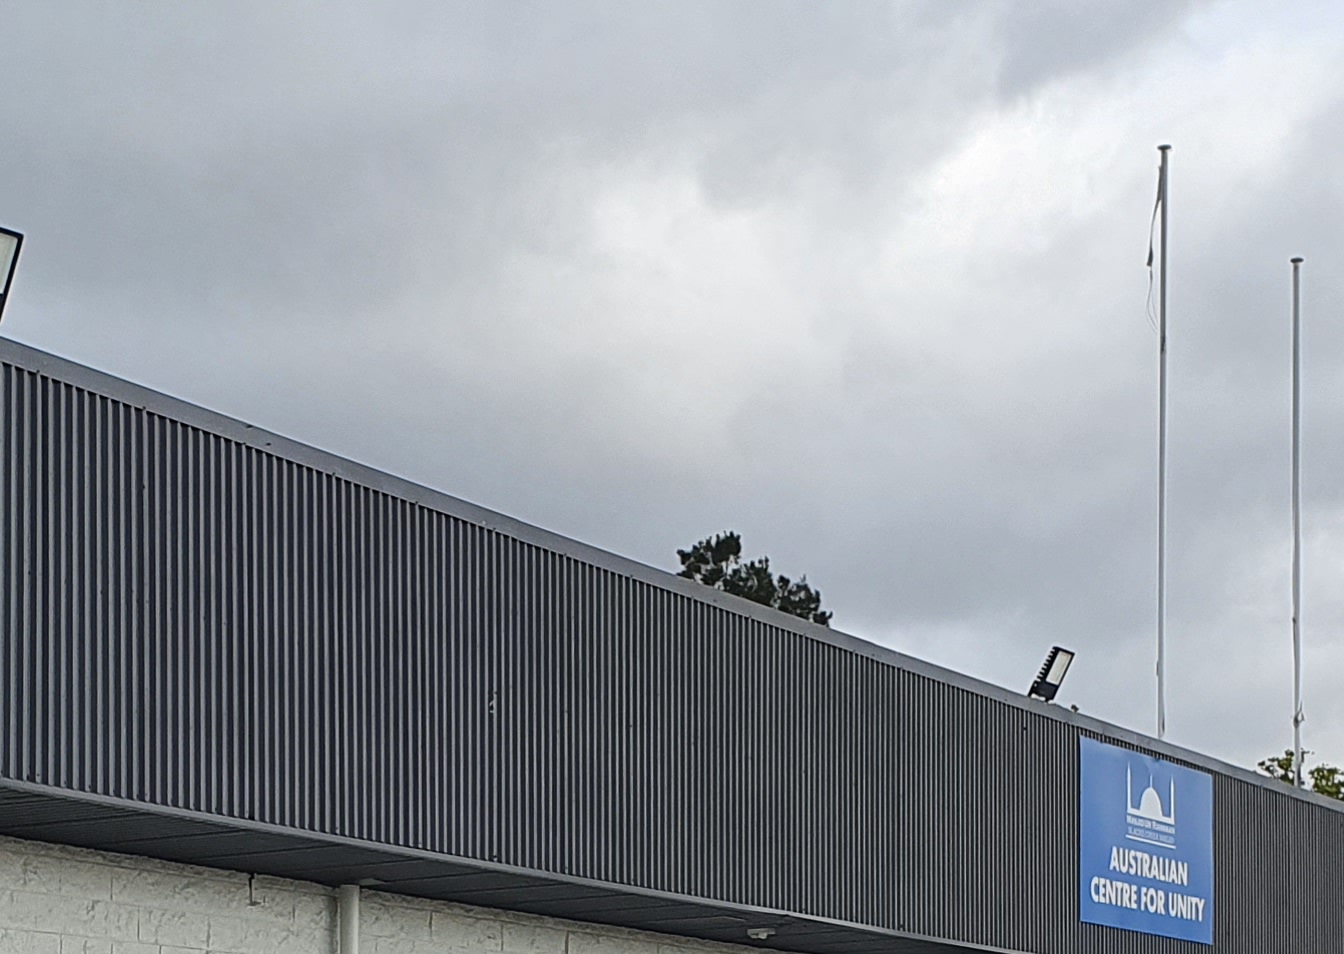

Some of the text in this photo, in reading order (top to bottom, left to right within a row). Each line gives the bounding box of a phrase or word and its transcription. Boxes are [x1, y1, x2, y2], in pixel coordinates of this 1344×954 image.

[1109, 846, 1188, 886] AUSTRALIAN
[1090, 876, 1205, 923] CENTRE FOR UNITY
